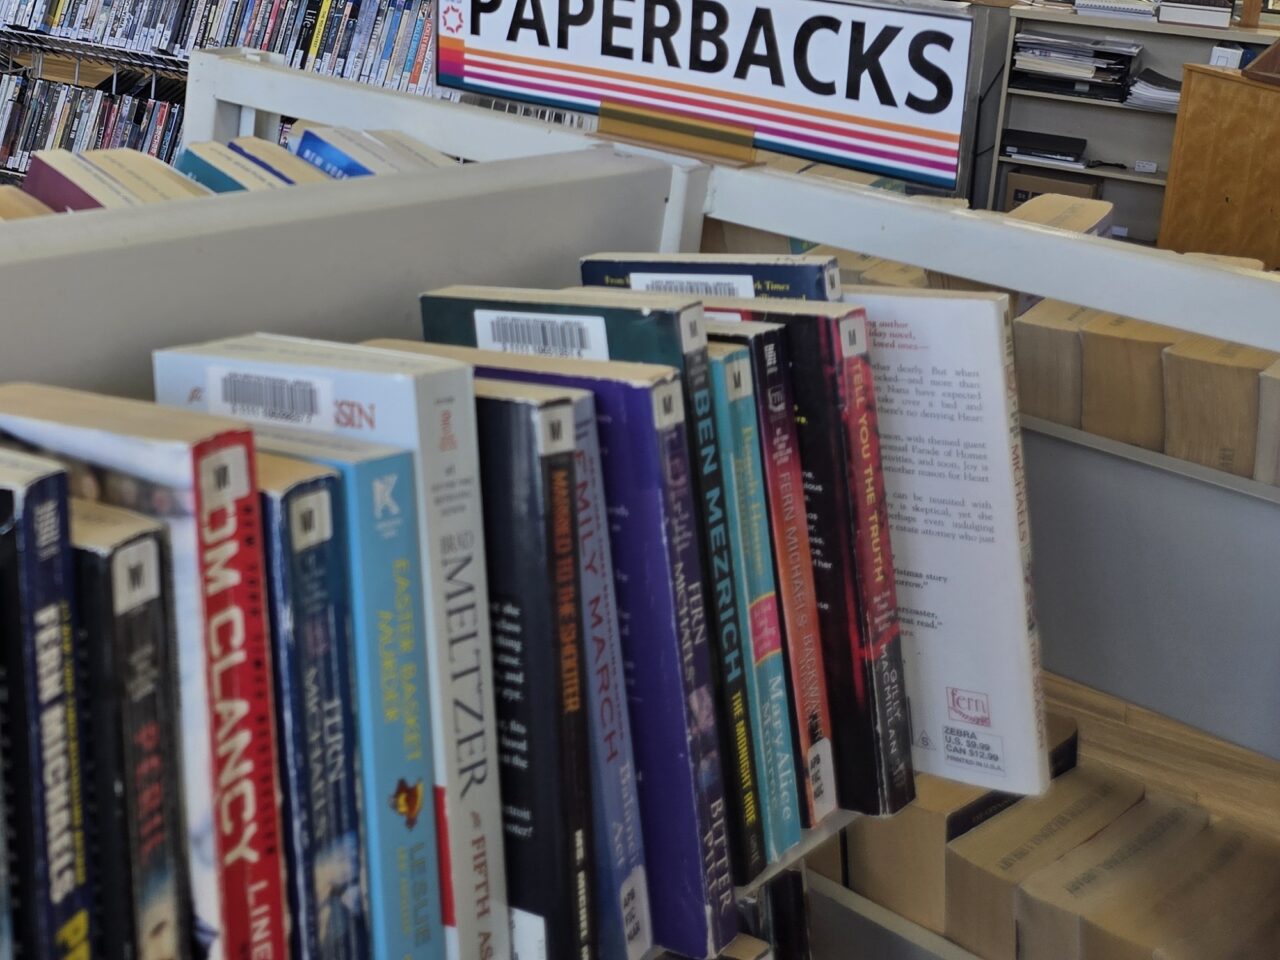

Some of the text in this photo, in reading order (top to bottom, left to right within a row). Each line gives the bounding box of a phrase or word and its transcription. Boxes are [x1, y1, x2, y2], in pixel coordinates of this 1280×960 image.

[302, 8, 316, 29] Life
[765, 280, 790, 291] Times
[920, 410, 955, 422] denying
[941, 390, 982, 401] expected
[850, 359, 884, 583] TELL YOU THE TRUTH
[929, 496, 965, 507] reunited
[1010, 441, 1027, 542] MICHAELS
[778, 470, 806, 628] FERN MICHAELS
[921, 527, 956, 540] attorney
[926, 573, 948, 583] story
[952, 520, 995, 534] indulging
[553, 470, 582, 712] MARRIED TO THE SHOOTER
[572, 449, 617, 763] EMILY MARCH
[672, 560, 696, 682] MICHAELS
[686, 580, 707, 645] FERN
[691, 388, 757, 827] BEN MEZRICH THE MIDNIGHT RIDE
[34, 603, 63, 704] FERN
[200, 498, 257, 868] OM CLANCY
[377, 609, 397, 725] MURDER
[393, 558, 420, 762] EASTER BASKET
[879, 643, 898, 755] MACMILLAN
[888, 667, 902, 723] GILLY
[304, 665, 327, 842] MICHAELS
[324, 695, 345, 784] FERN
[442, 553, 490, 803] MELTZER
[470, 834, 491, 920] FIFTH
[758, 702, 781, 805] Monroe
[764, 674, 797, 822] Mary Alice
[943, 725, 978, 740] ZEBRA
[945, 735, 991, 752] U.S. $9.99
[946, 743, 999, 762] CAN $12.99
[38, 704, 75, 905] MICHAELS
[134, 719, 167, 864] PERIL
[708, 796, 735, 916] BITTER
